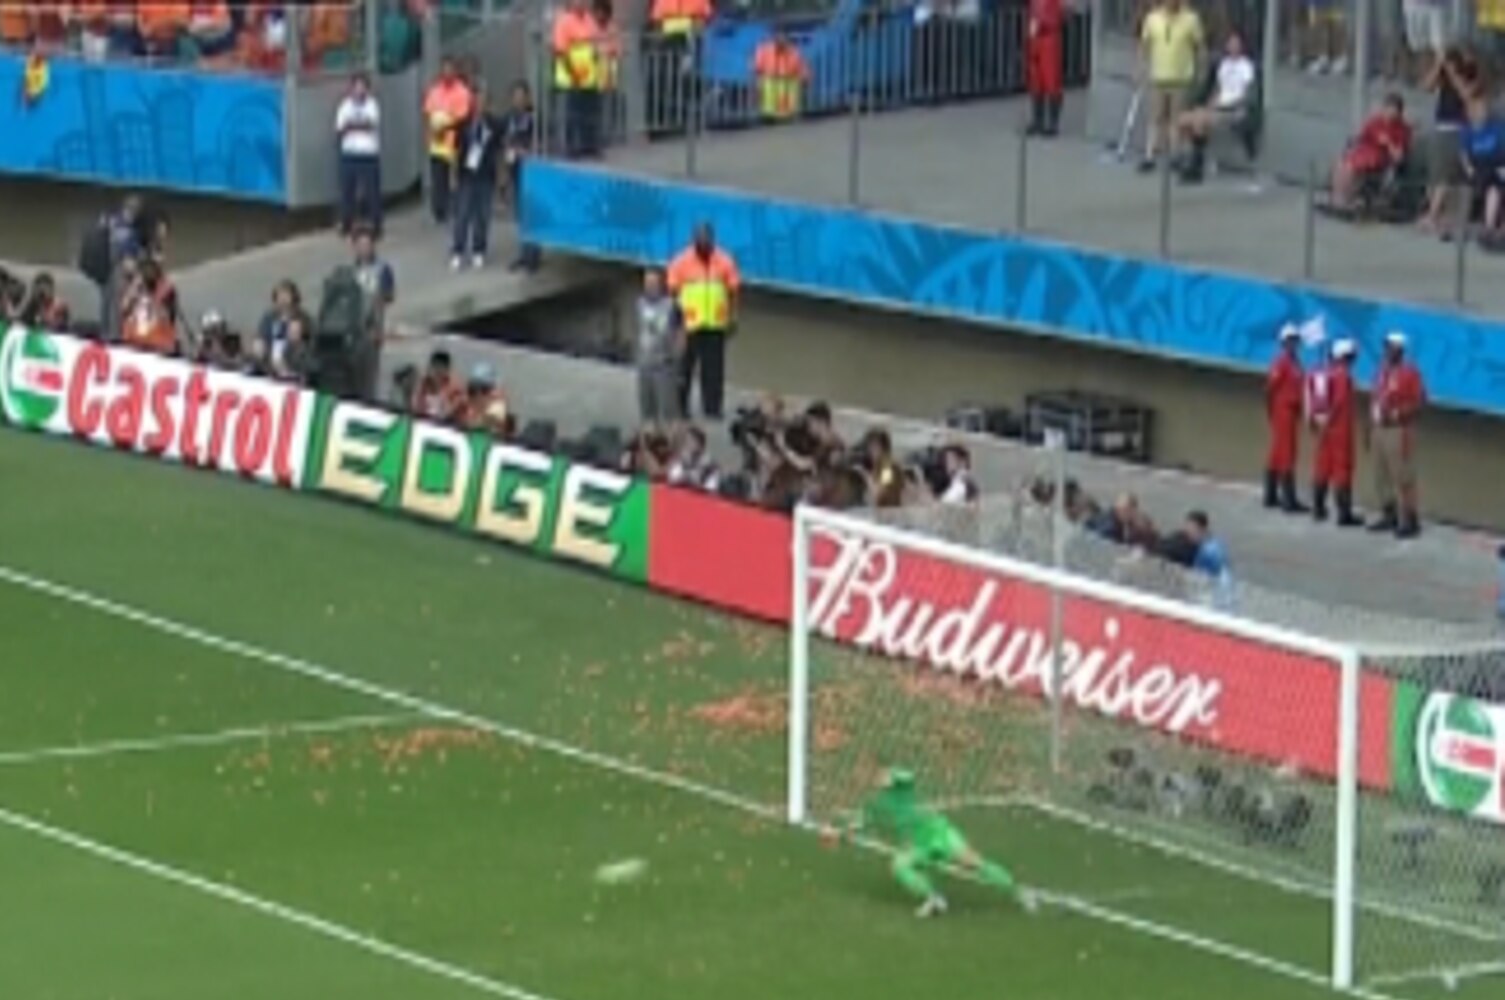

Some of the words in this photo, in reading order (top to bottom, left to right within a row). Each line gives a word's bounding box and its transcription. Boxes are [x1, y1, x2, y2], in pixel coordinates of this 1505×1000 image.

[66, 338, 302, 490] Castrol
[320, 401, 632, 567] EDGE
[792, 523, 1223, 732] Budweiser
